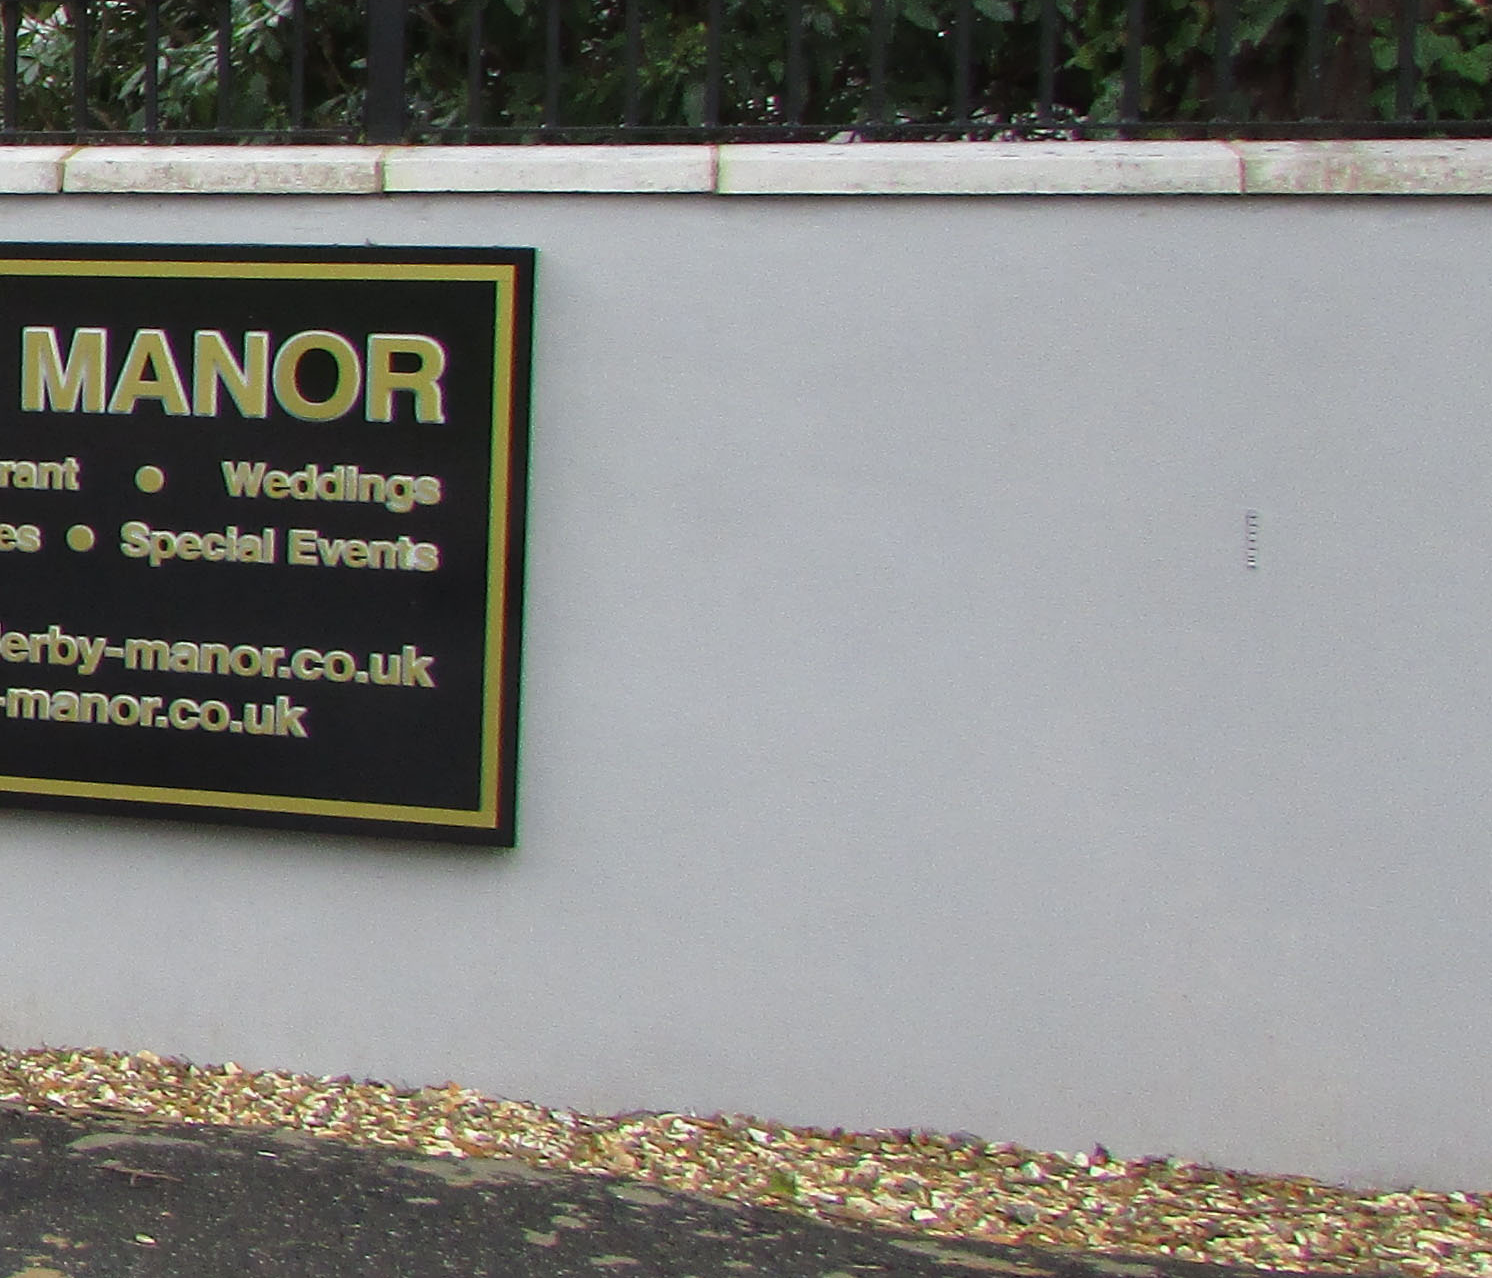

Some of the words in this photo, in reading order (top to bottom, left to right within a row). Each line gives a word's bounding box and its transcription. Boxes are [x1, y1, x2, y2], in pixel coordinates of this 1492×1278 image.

[22, 326, 448, 424] MANOR
[221, 461, 443, 512] Weddings
[120, 521, 277, 567] Special
[288, 529, 440, 571] Events
